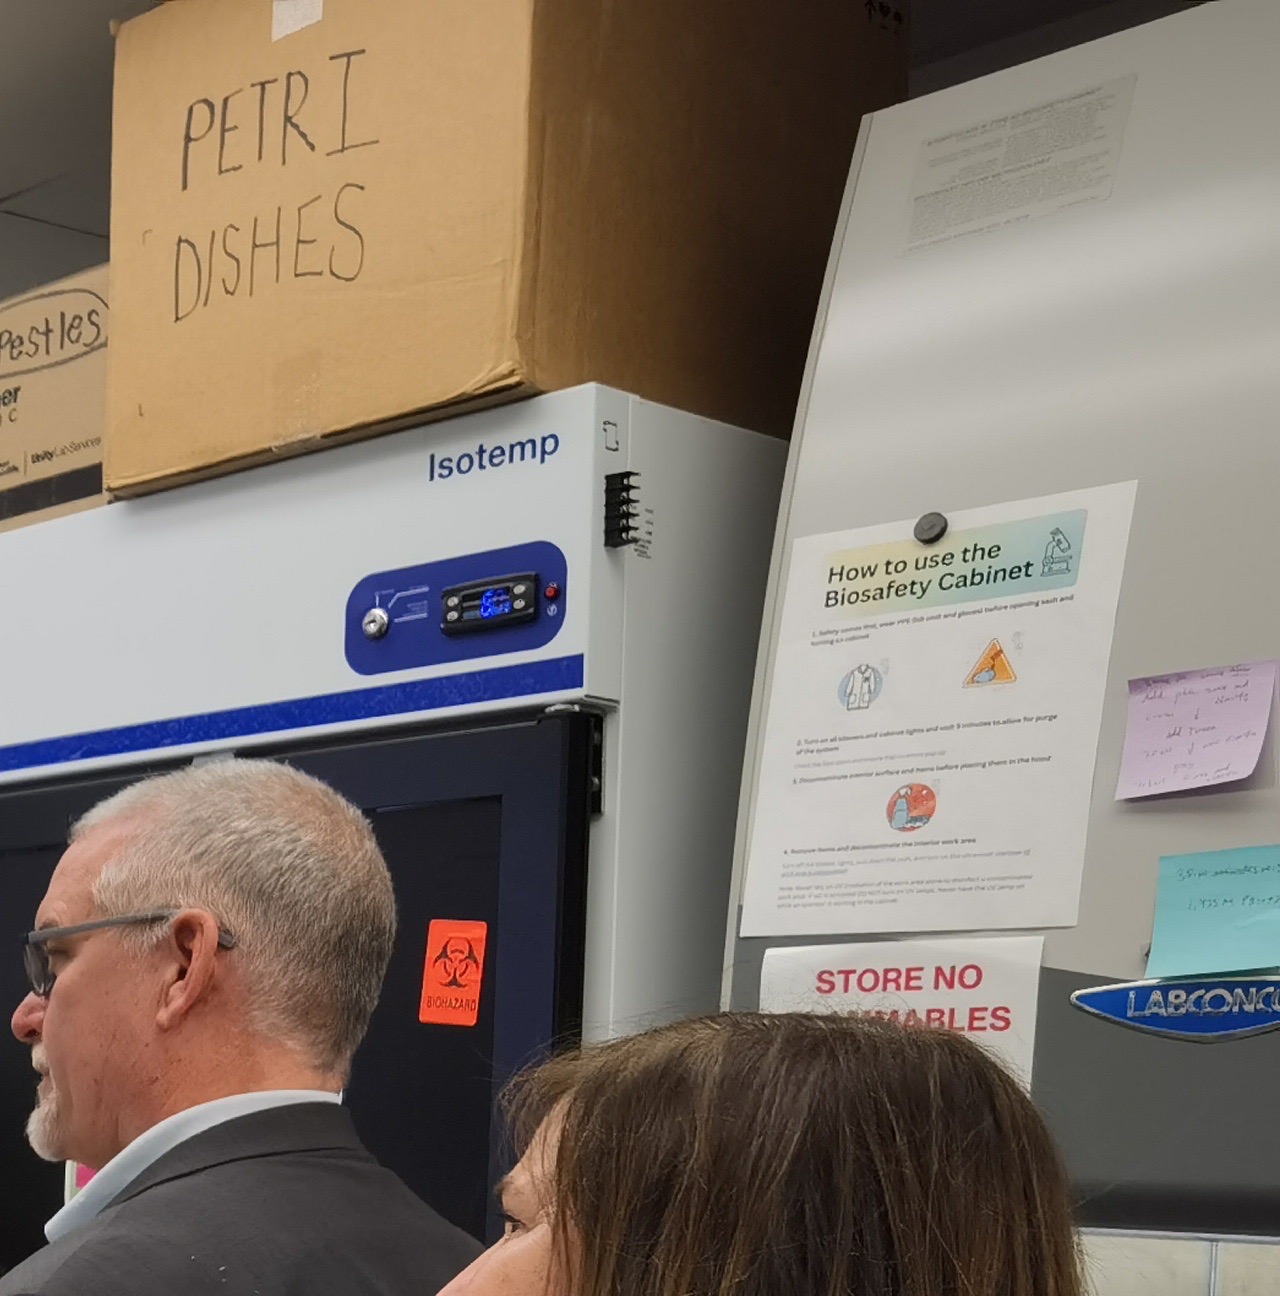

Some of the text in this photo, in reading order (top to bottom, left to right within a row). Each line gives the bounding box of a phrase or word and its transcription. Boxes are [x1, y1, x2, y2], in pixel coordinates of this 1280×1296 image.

[181, 48, 380, 192] PETRI
[173, 182, 366, 324] DISHES
[428, 432, 560, 482] Isotemp
[824, 560, 1035, 608] Biosafety Cabinet
[827, 542, 1002, 584] How to use the
[815, 963, 984, 995] STORE NO
[426, 995, 478, 1013] BIOHAZARD
[860, 1005, 1012, 1034] ABLES
